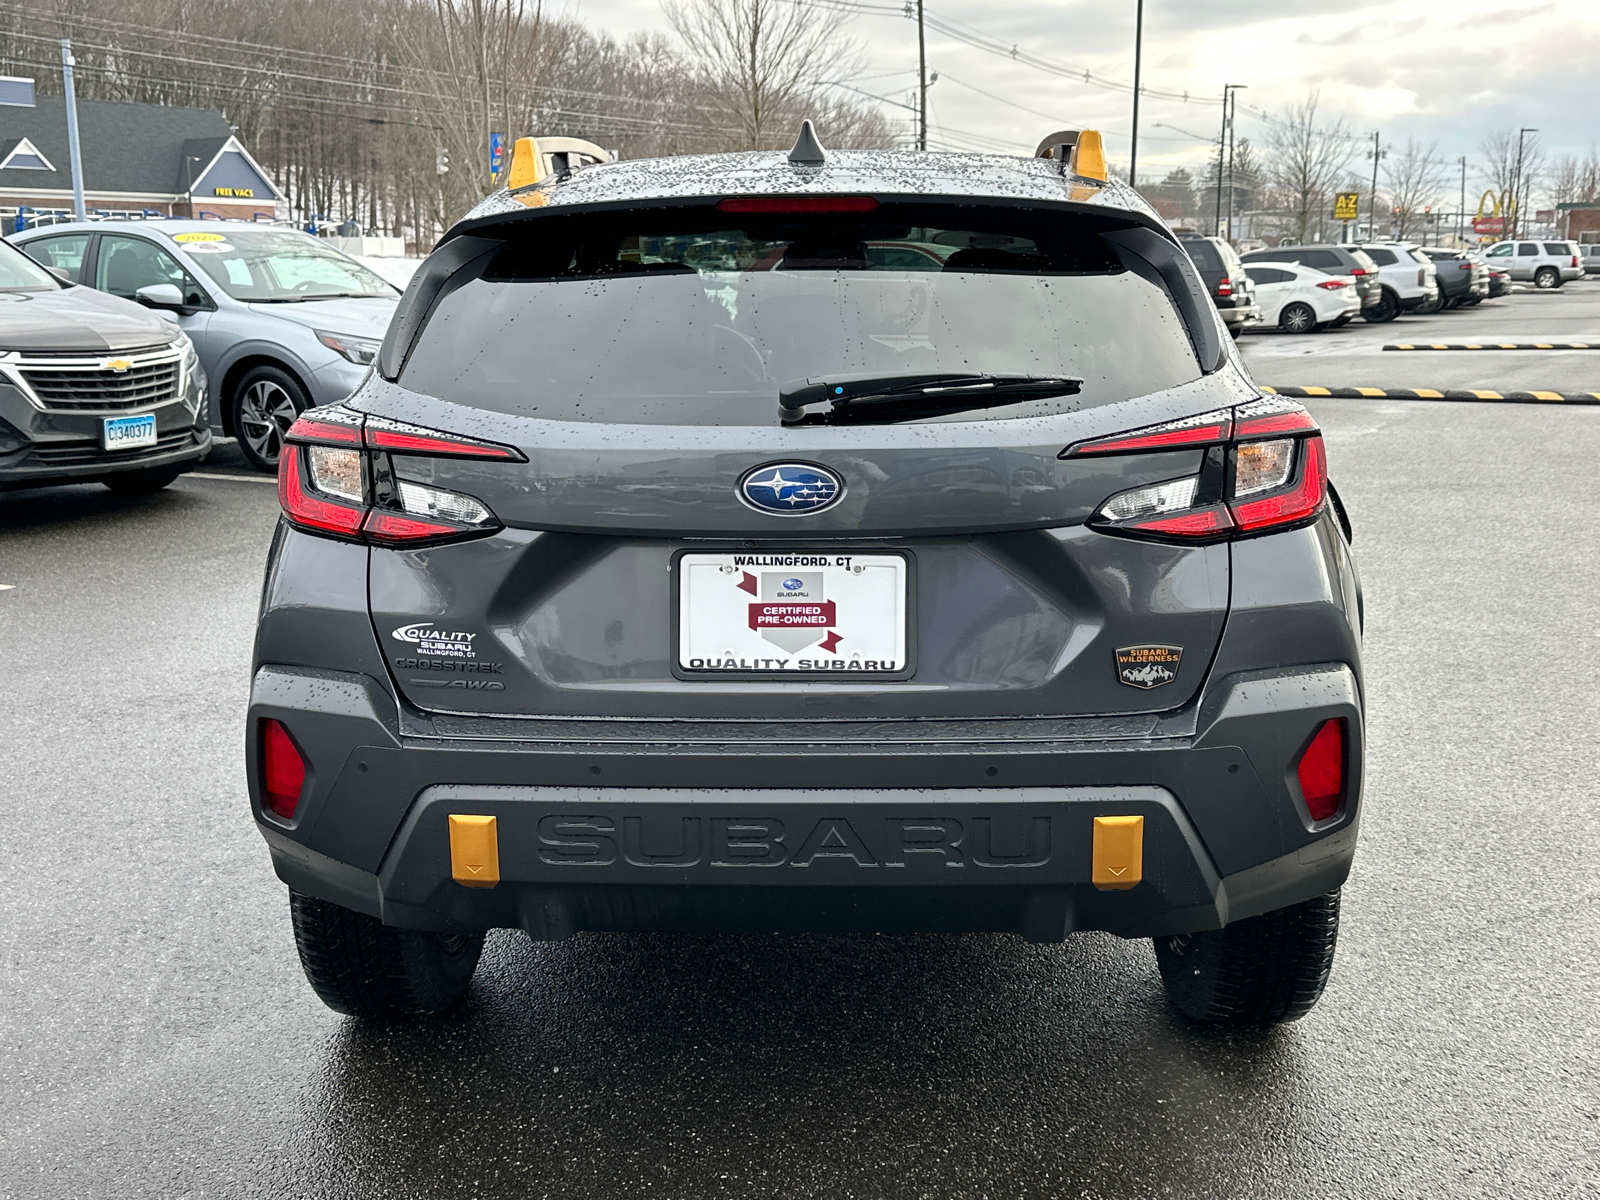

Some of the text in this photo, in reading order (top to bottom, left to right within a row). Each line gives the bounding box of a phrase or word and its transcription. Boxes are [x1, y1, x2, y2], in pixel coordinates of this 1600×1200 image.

[215, 187, 254, 198] FREE VACS
[734, 556, 853, 567] WALLINGFORD, CT
[763, 606, 821, 615] CERTIFIED
[757, 616, 827, 624] PRE-OWNED
[406, 628, 477, 642] QUALITY
[420, 641, 472, 652] SUBARU
[1130, 648, 1169, 656] SUBARU
[417, 648, 466, 658] WALLINGFORD,
[1119, 654, 1179, 663] WILDERNESS
[395, 657, 505, 674] CROSSTREK
[689, 658, 896, 670] QUALITY SUBARU
[441, 680, 506, 691] AWD
[536, 814, 1053, 868] SUBARU
